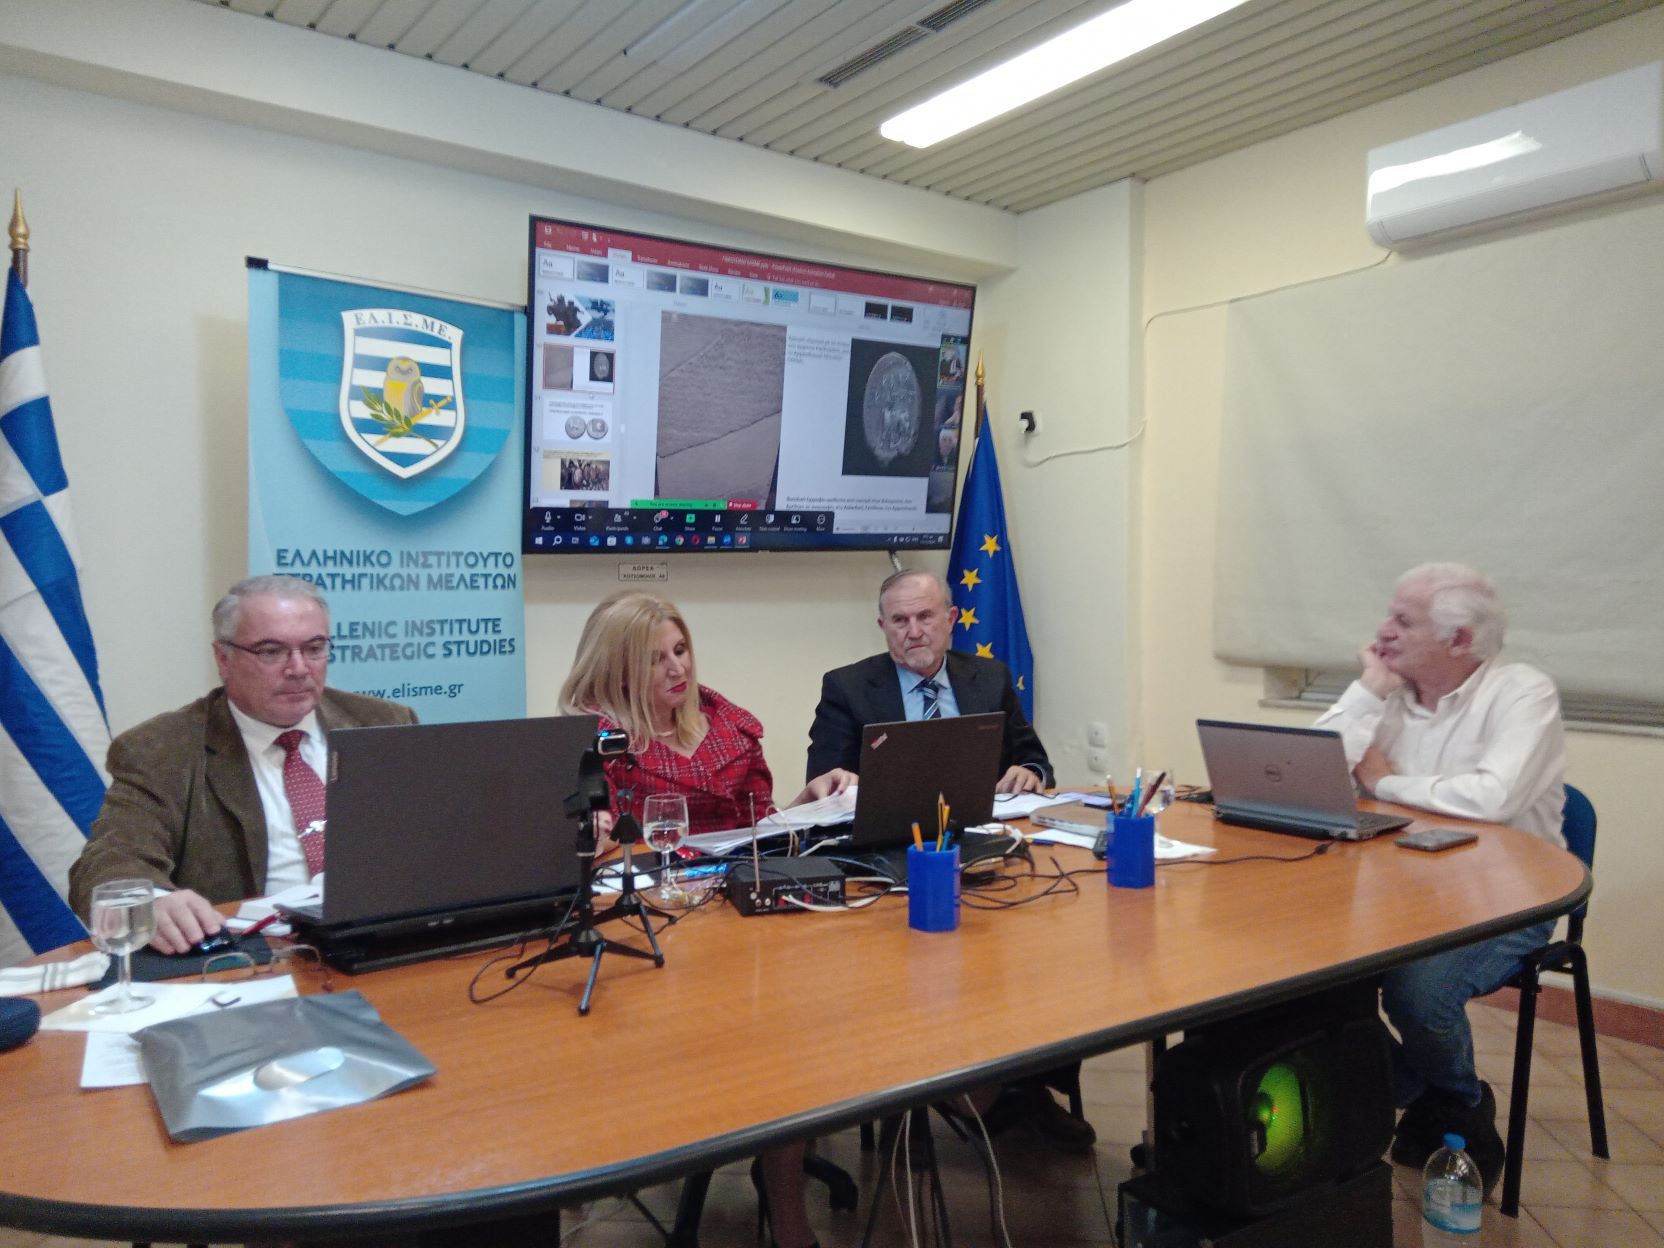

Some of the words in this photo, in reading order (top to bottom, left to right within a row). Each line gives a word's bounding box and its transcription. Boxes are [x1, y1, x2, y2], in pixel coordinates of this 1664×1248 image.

[277, 548, 393, 567] ΕΛΛΗΝΙΚΟ
[400, 549, 515, 568] ΙΝΣΤΙΤΟΥΤΟ
[272, 572, 420, 591] ΡΑΤΗΓΙΚΩΝ
[426, 573, 517, 591] ΜΕΛΕΤΩΝ
[404, 617, 502, 638] INSTITUTE
[442, 638, 516, 658] STUDIES
